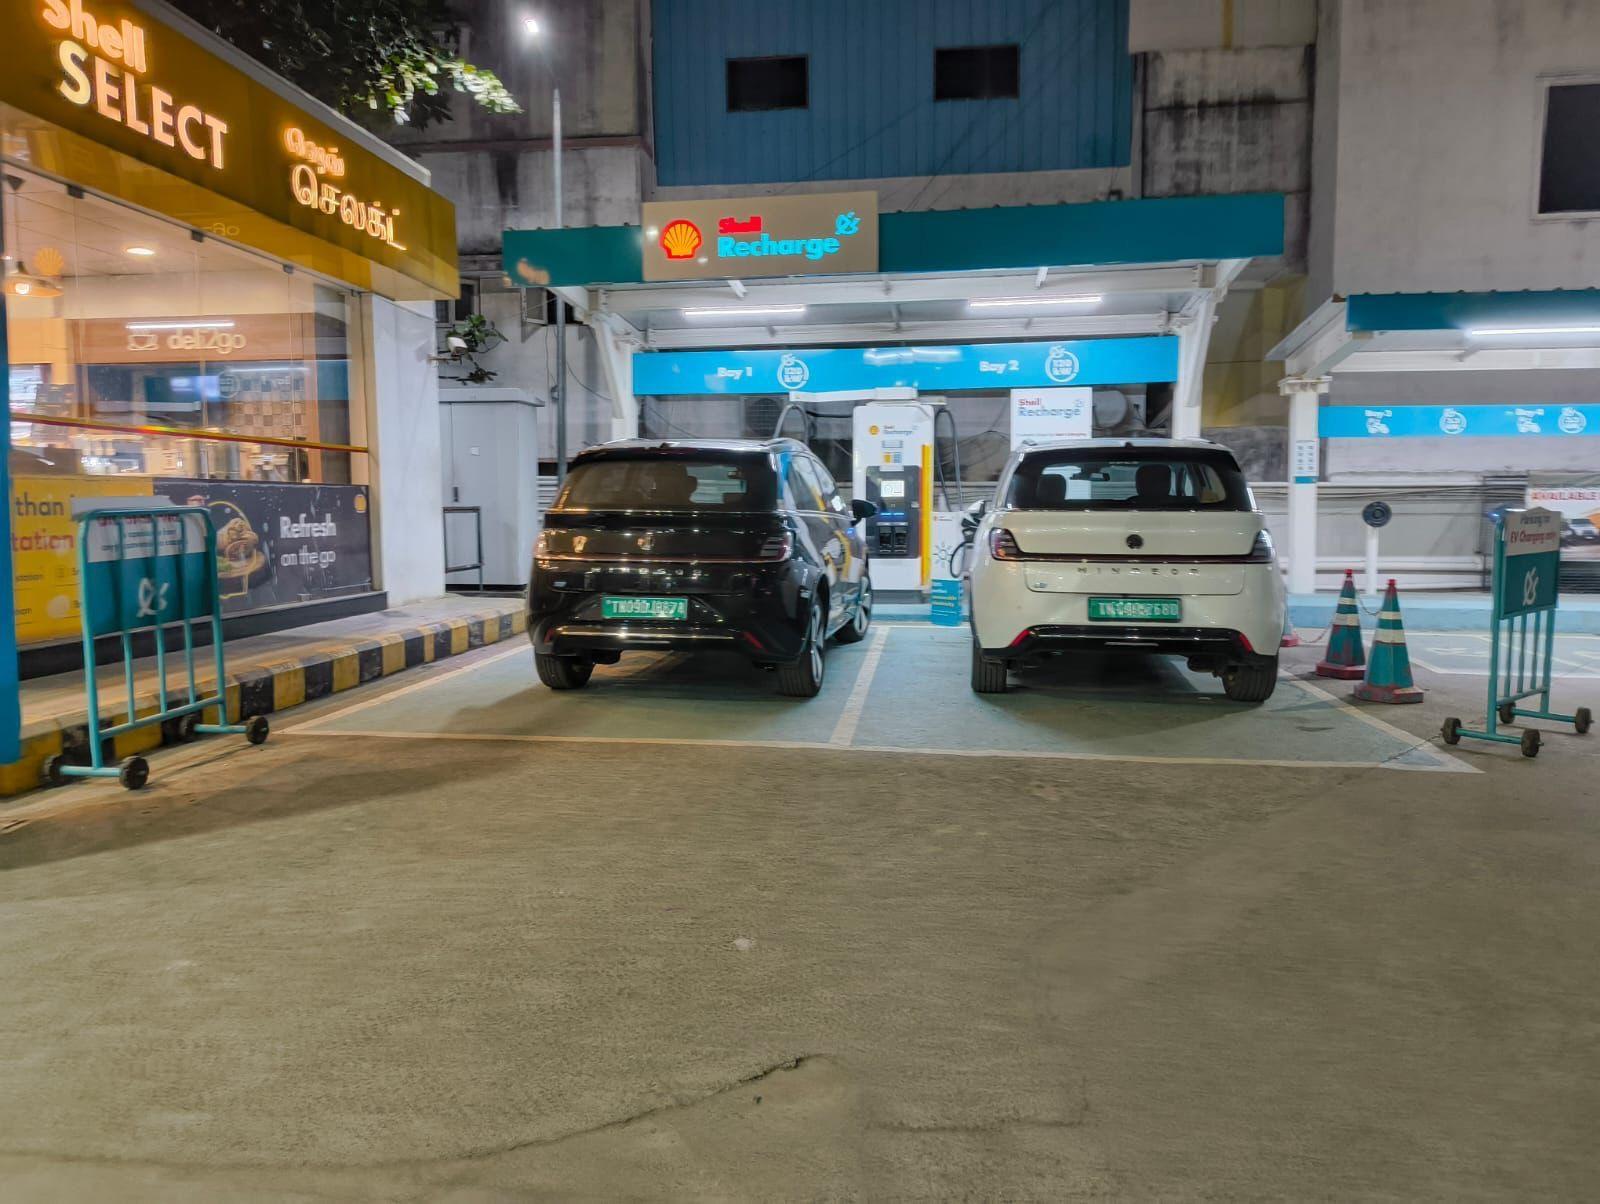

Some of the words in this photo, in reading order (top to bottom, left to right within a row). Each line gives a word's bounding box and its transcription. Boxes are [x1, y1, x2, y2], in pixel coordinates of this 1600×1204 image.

[43, 0, 147, 73] Shell
[57, 40, 228, 170] SELECT
[717, 233, 841, 261] Recharge
[717, 367, 744, 380] Bay
[745, 366, 753, 377] 1
[979, 361, 1007, 374] Bay
[1008, 360, 1020, 371] 2
[16, 491, 65, 517] than
[280, 513, 337, 539] Refresh
[281, 553, 298, 567] on
[299, 545, 319, 565] the
[320, 551, 337, 569] go
